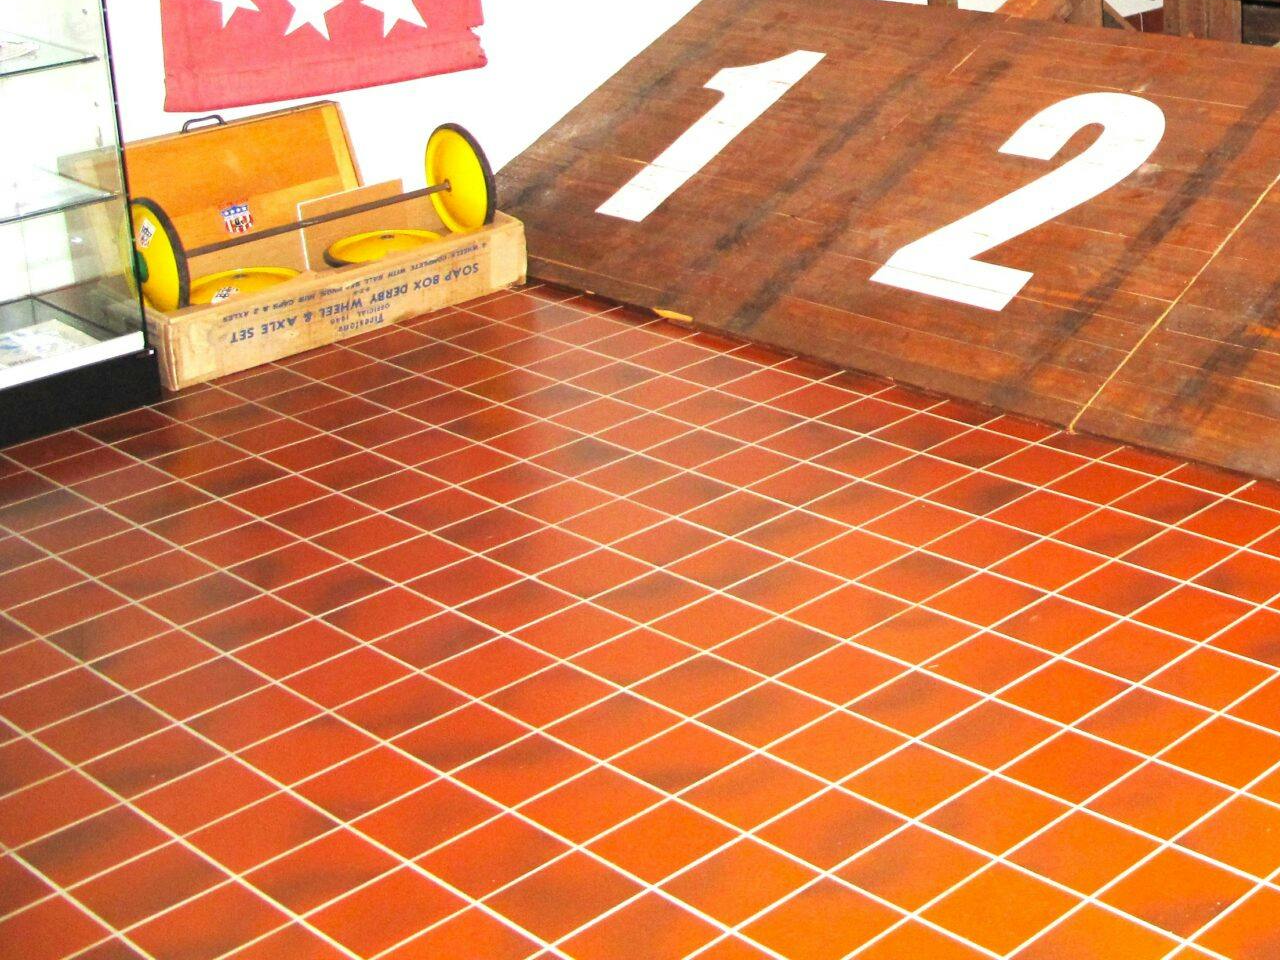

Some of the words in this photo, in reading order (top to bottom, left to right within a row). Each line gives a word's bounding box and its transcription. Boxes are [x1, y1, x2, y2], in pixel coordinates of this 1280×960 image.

[595, 49, 827, 222] 1
[869, 92, 1166, 311] 2
[444, 263, 479, 282] SOAP
[413, 275, 440, 290] BOX
[370, 283, 408, 304] DERBY
[319, 298, 363, 318] WHEEL
[230, 327, 254, 343] SET
[261, 316, 297, 335] AXLE
